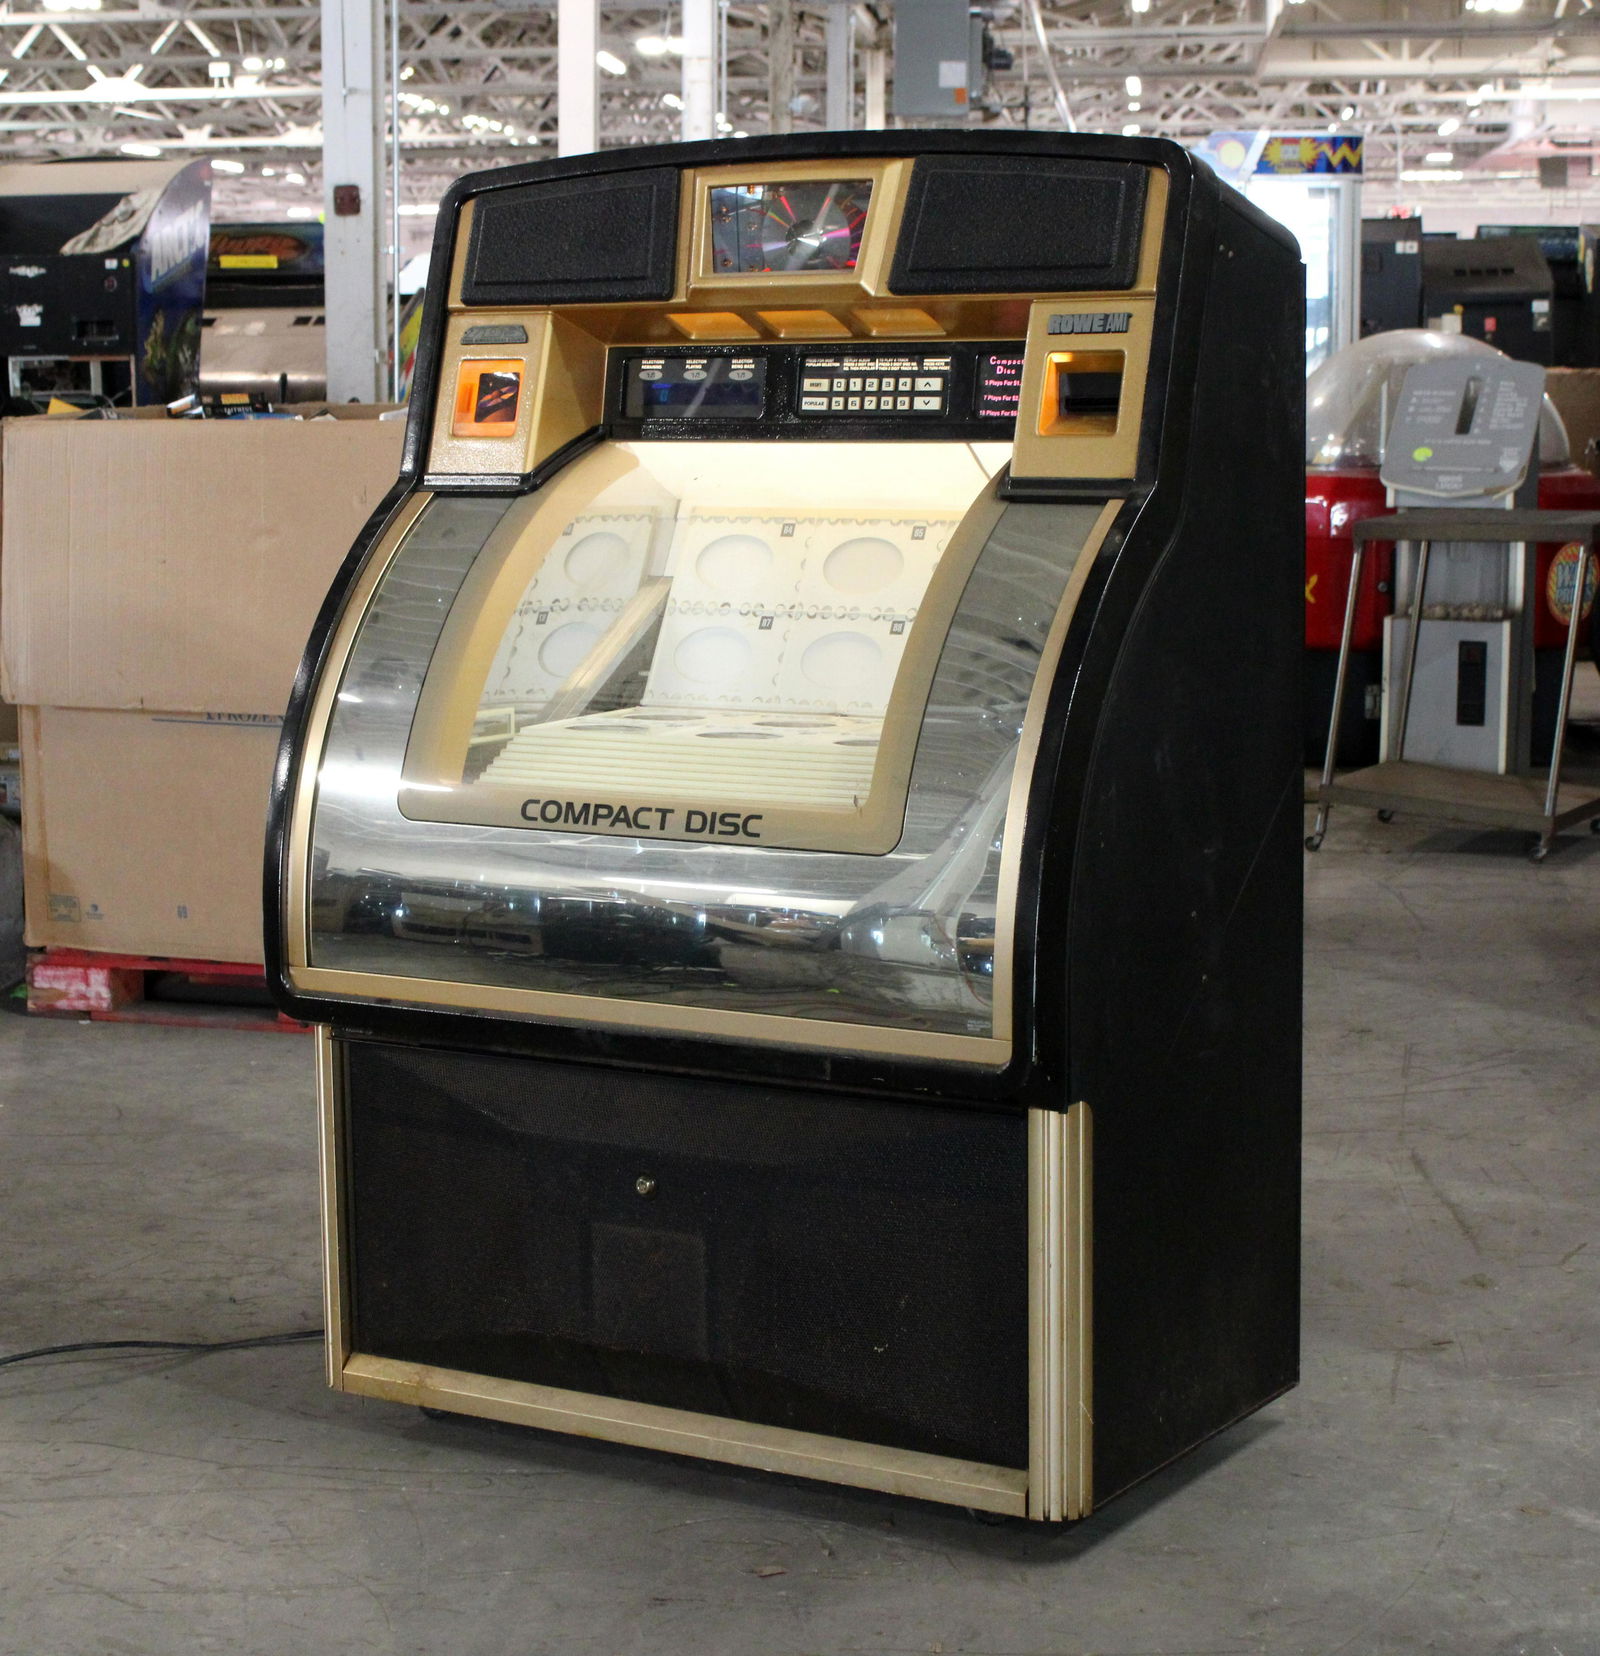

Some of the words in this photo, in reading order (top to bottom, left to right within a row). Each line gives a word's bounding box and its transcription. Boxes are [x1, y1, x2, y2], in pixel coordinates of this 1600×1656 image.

[1048, 314, 1105, 334] ROWE
[1105, 312, 1129, 333] AMI
[521, 799, 675, 831] COMPACT
[685, 810, 763, 838] DISC
